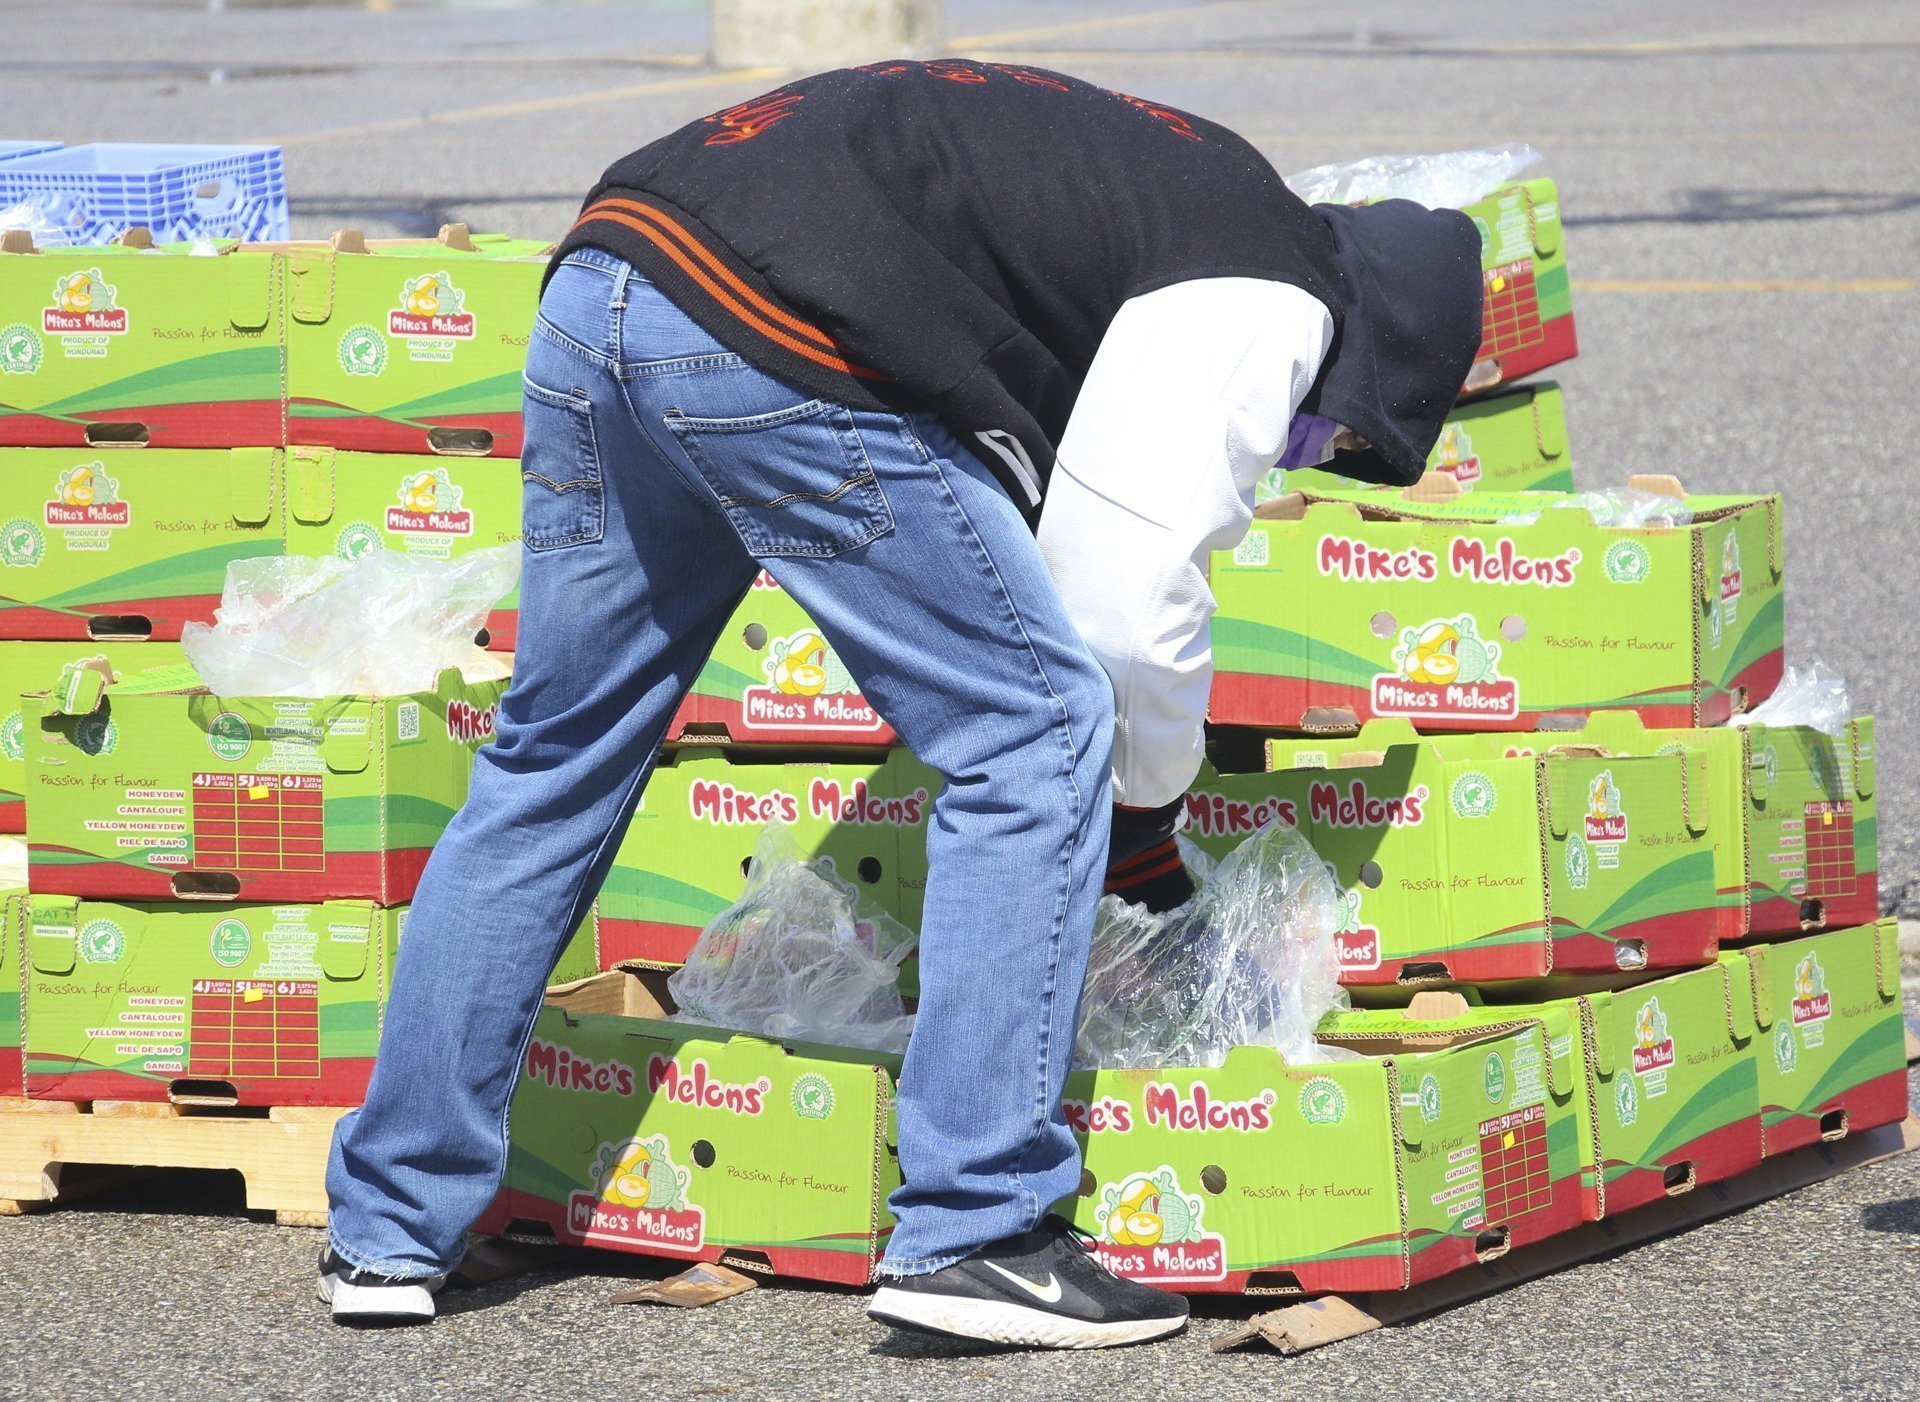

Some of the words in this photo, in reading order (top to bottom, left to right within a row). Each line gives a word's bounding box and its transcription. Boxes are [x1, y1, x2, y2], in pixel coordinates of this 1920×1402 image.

[46, 313, 80, 328] Mike's
[85, 313, 124, 329] Melons
[392, 317, 427, 331] Mike's
[432, 317, 471, 333] Melons
[153, 328, 194, 338] Passion
[201, 328, 216, 341] for
[500, 334, 531, 345] Passi
[411, 352, 450, 360] HONDURAS
[49, 507, 84, 520] Mike's
[88, 507, 124, 521] Melons
[389, 513, 424, 528] Mike's
[429, 514, 466, 530] Melons
[155, 521, 196, 531] Passion
[202, 521, 218, 533] for
[1320, 537, 1435, 578] Mike's
[1544, 635, 1593, 648] Passion
[1600, 636, 1621, 652] for
[1627, 638, 1676, 650] Flavour
[1379, 685, 1438, 708] Mike's
[751, 697, 806, 720] Mike's
[814, 698, 872, 721] Melons
[216, 743, 229, 751] ISO
[230, 743, 246, 751] 9001
[39, 774, 84, 786] Passion
[90, 775, 108, 789] for
[114, 774, 159, 787] Flavour
[194, 774, 211, 786] 4J
[238, 775, 254, 787] 5J
[283, 776, 300, 788] 6J
[692, 781, 798, 823] Mike's
[119, 806, 185, 814] CANTALOUPE
[1185, 792, 1296, 834] Mike's
[87, 822, 127, 830] YELLOW
[129, 822, 185, 830] HONEYDEW
[1586, 821, 1604, 836] Mike's
[120, 838, 140, 846] PIEL
[159, 839, 186, 847] SAPO
[1640, 835, 1663, 846] Passion
[1665, 832, 1674, 848] for
[150, 855, 187, 863] SANDIA
[1400, 879, 1445, 890] Passion
[1451, 877, 1469, 893] for
[1477, 875, 1526, 887] Flavour
[33, 909, 62, 919] CAT
[65, 911, 72, 920] 1
[1337, 938, 1371, 960] lons
[38, 984, 86, 994] Passion
[92, 983, 113, 998] for
[119, 981, 161, 994] Flavour
[194, 981, 210, 993] 4J
[278, 983, 296, 994] 6J
[1635, 1053, 1652, 1068] Mike's
[1686, 1051, 1710, 1065] Passion
[1712, 1047, 1721, 1062] for
[527, 1040, 634, 1096] Mike's
[1401, 1075, 1412, 1085] CAT
[1063, 1101, 1130, 1132] ke's
[1501, 1115, 1510, 1128] 5J
[1524, 1108, 1533, 1120] 6J
[1480, 1123, 1488, 1135] 4J
[1431, 1142, 1440, 1160] for
[1442, 1136, 1464, 1151] Flavour
[1449, 1146, 1477, 1161] HONEYDEW
[726, 1165, 772, 1184] Passion
[778, 1170, 798, 1187] for
[803, 1176, 849, 1193] Flavour
[1446, 1164, 1478, 1180] CANTALOUPE
[1241, 1185, 1289, 1198] Passion
[1297, 1185, 1319, 1201] for
[1324, 1183, 1373, 1196] Flavour
[1432, 1189, 1452, 1203] YELLOW
[1452, 1181, 1480, 1196] HONEYDEW
[1449, 1206, 1460, 1215] PIEL
[1461, 1204, 1467, 1212] DE
[1468, 1198, 1481, 1209] SAPO
[574, 1202, 629, 1231] Mike's
[1464, 1216, 1483, 1227] SANDIA
